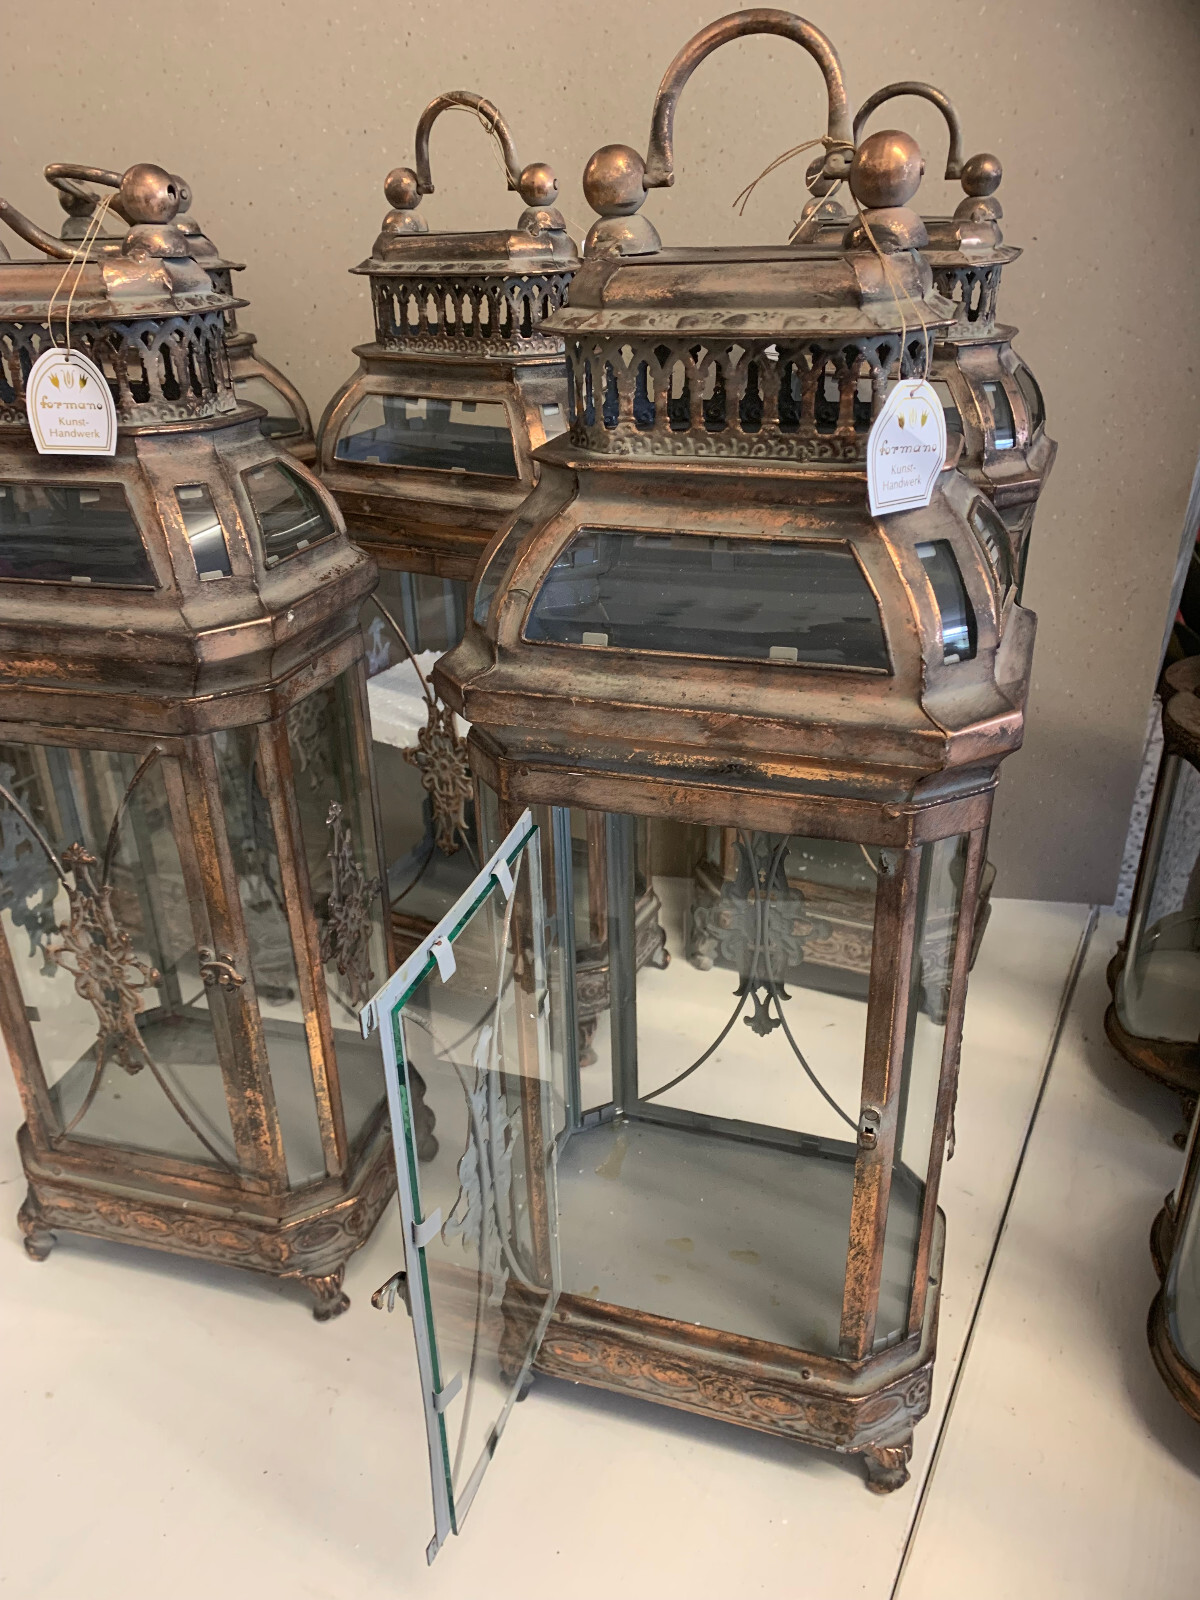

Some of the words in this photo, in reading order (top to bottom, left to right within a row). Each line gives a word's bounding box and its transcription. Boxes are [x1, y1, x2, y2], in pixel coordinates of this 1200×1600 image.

[40, 395, 103, 410] formano
[58, 417, 90, 427] Kunst-
[49, 428, 100, 438] Handwerk
[880, 440, 937, 456] formano
[891, 463, 916, 475] Kunst-
[882, 475, 921, 491] Handwerk
